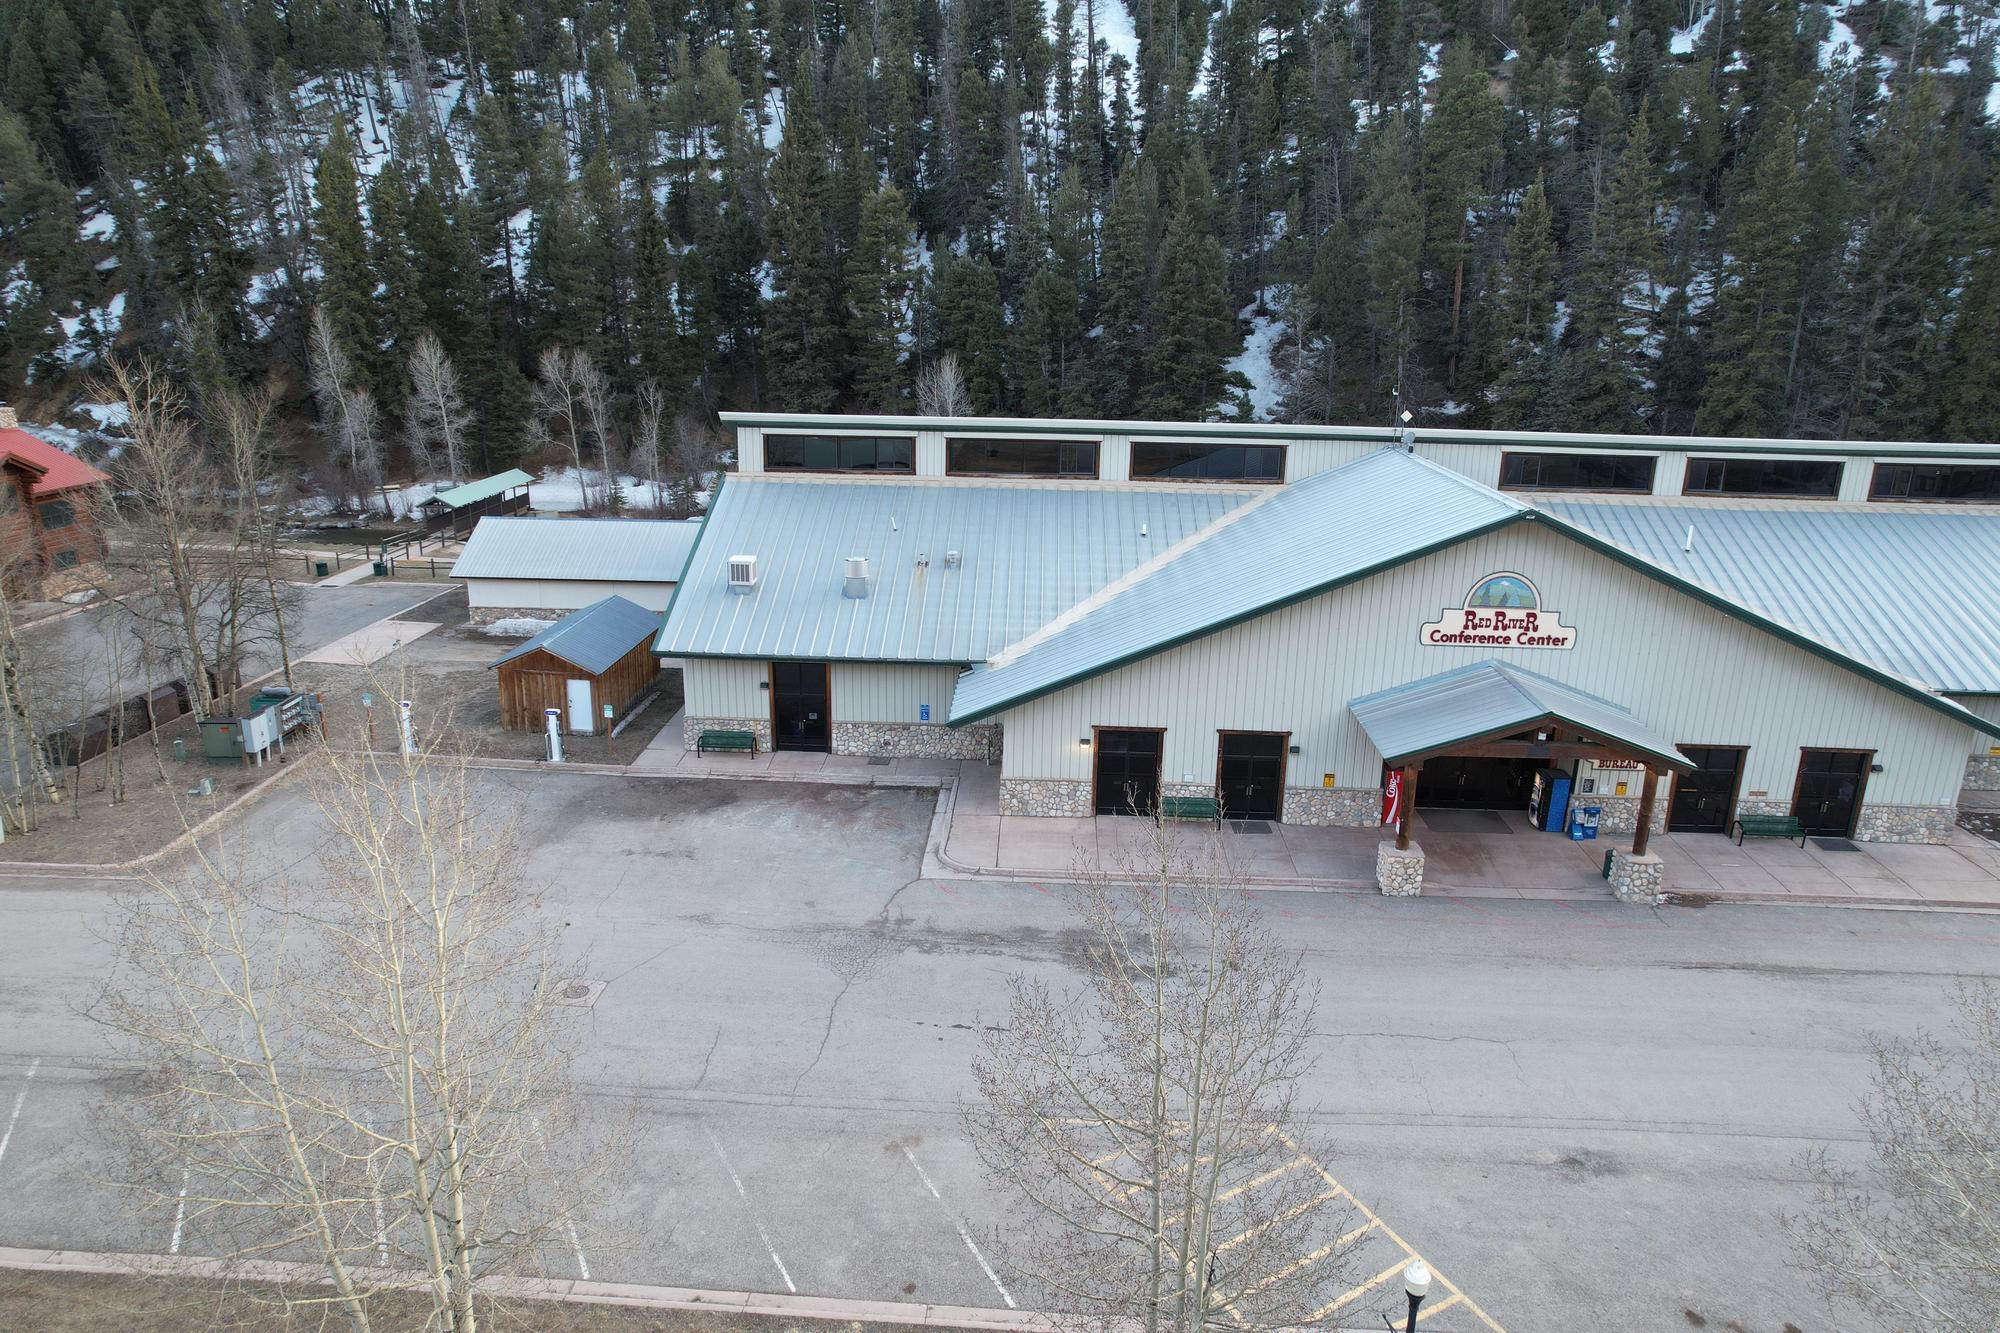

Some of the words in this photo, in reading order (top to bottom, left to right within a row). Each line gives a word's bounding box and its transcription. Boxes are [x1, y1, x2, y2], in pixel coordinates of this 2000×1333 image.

[1463, 610, 1491, 630] RED
[1493, 611, 1539, 632] RIVER
[1430, 630, 1512, 645] Conference
[1517, 632, 1568, 646] Center
[1599, 760, 1638, 769] BUREAU
